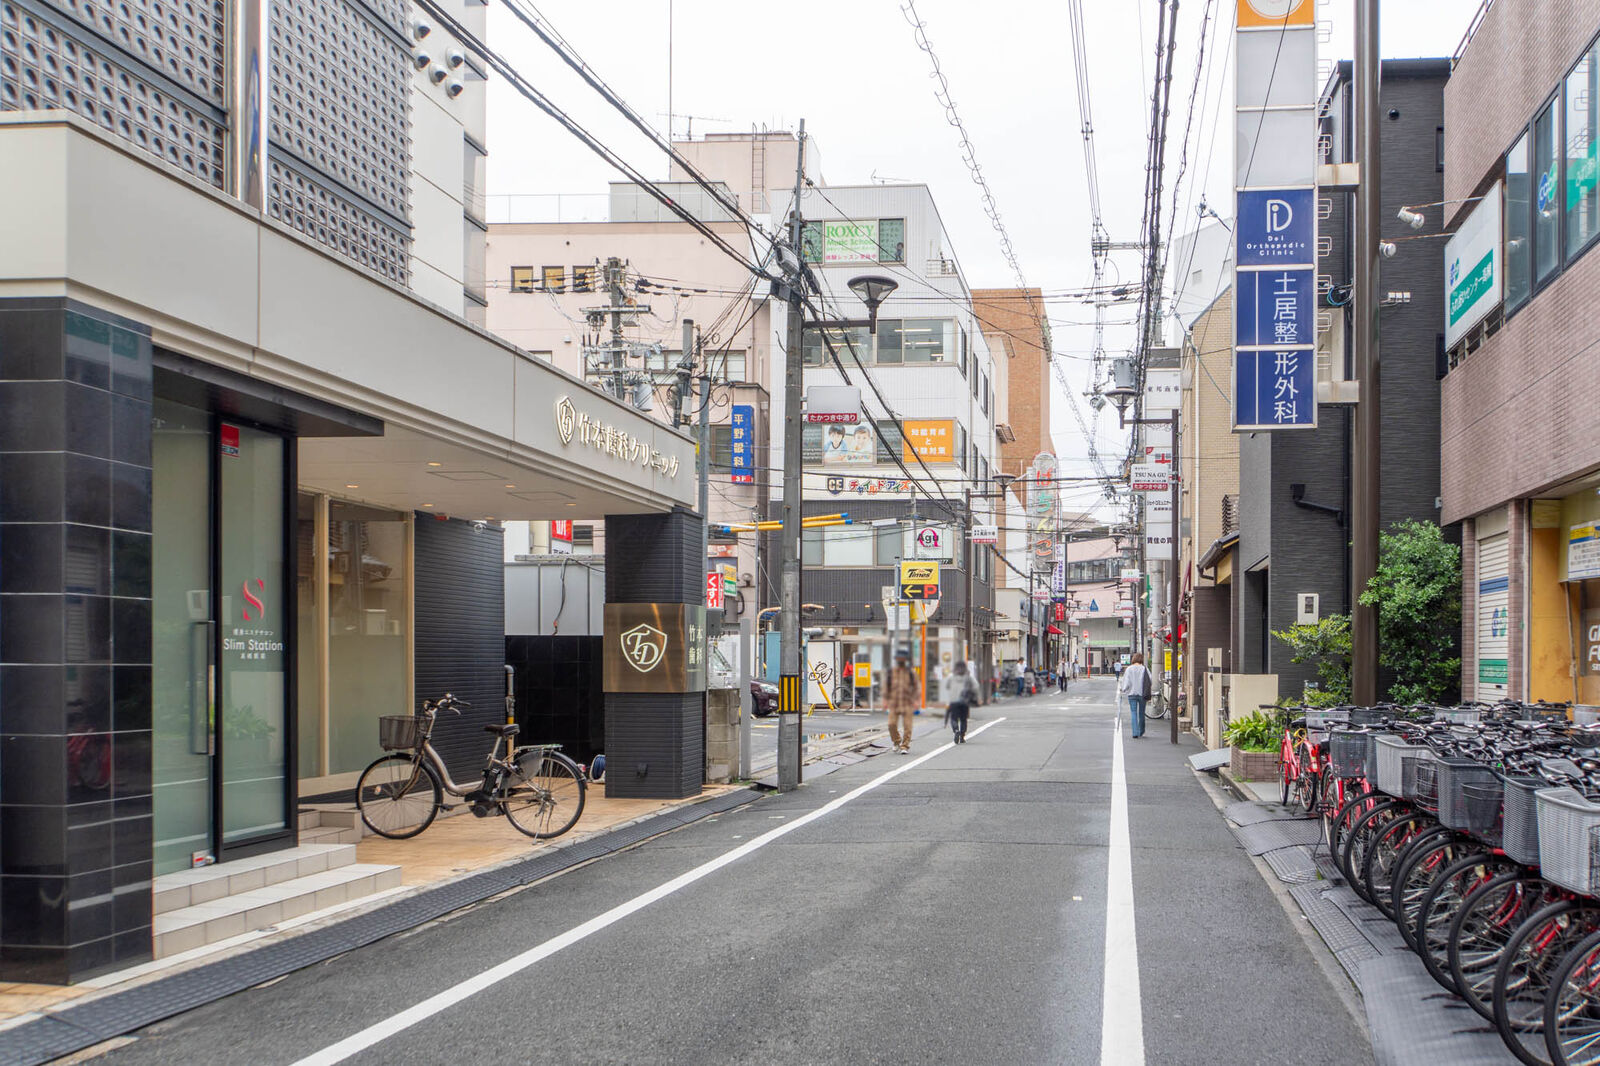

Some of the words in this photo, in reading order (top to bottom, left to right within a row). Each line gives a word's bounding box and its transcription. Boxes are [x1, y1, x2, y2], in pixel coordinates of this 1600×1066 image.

[1274, 272, 1298, 424] 土居整形外科
[809, 413, 856, 421] たかつき中通り
[578, 412, 680, 479] 竹本歯科クリニック
[917, 533, 939, 543] Agu
[908, 568, 934, 578] Times
[924, 584, 937, 599] P
[223, 638, 245, 650] Slim
[248, 639, 283, 651] Station
